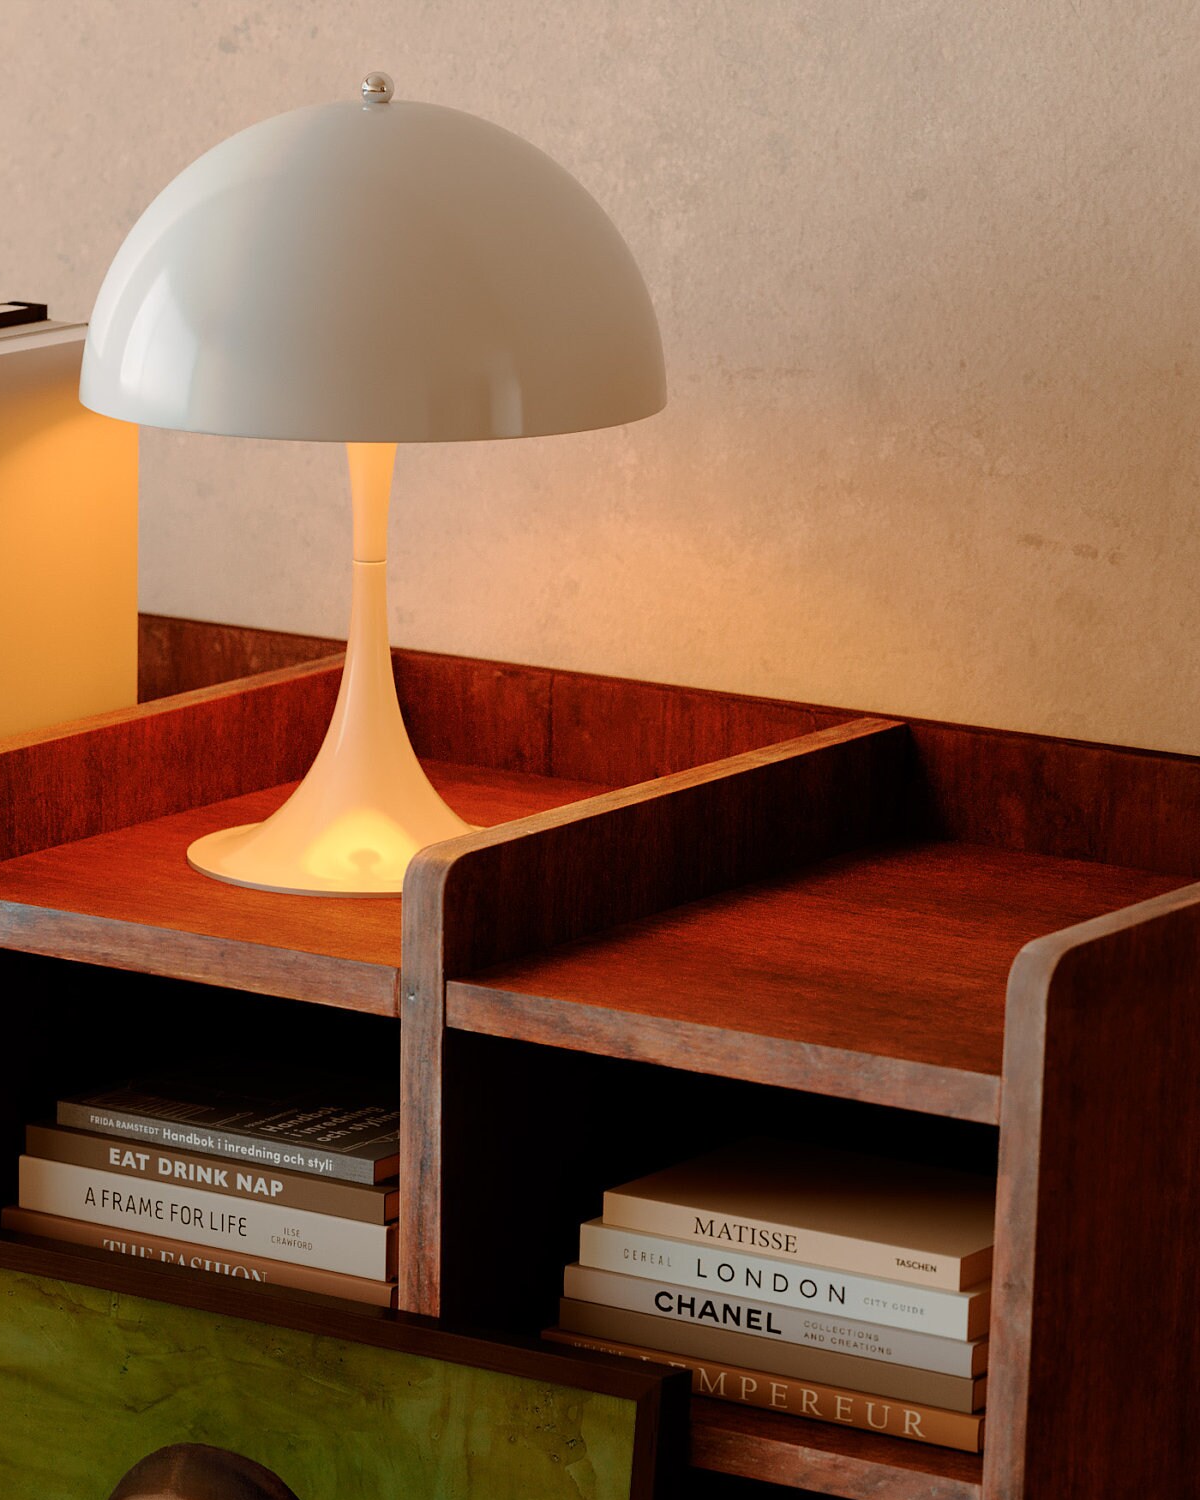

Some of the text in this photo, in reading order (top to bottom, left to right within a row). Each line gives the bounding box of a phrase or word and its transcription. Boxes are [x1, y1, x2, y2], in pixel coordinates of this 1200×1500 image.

[90, 1115, 114, 1128] FRIDA
[116, 1120, 159, 1135] RAMSTEDT
[163, 1128, 214, 1149] Handbok
[224, 1140, 281, 1164] inredning
[283, 1153, 304, 1166] och
[109, 1147, 284, 1197] EAT DRINK NAP
[85, 1187, 247, 1237] A FRAME FOR LIFE
[284, 1227, 300, 1237] ILSE
[271, 1235, 313, 1251] CRAWFORD
[693, 1216, 937, 1273] MATISSE TASCHEN
[623, 1248, 925, 1315] CEREAL LONDON CITY GUIDE
[654, 1291, 782, 1335] CHANEL
[803, 1320, 880, 1342] COLLECTIONS
[803, 1332, 893, 1356] AND CREATIONS
[640, 1356, 926, 1438] MPEREUR
